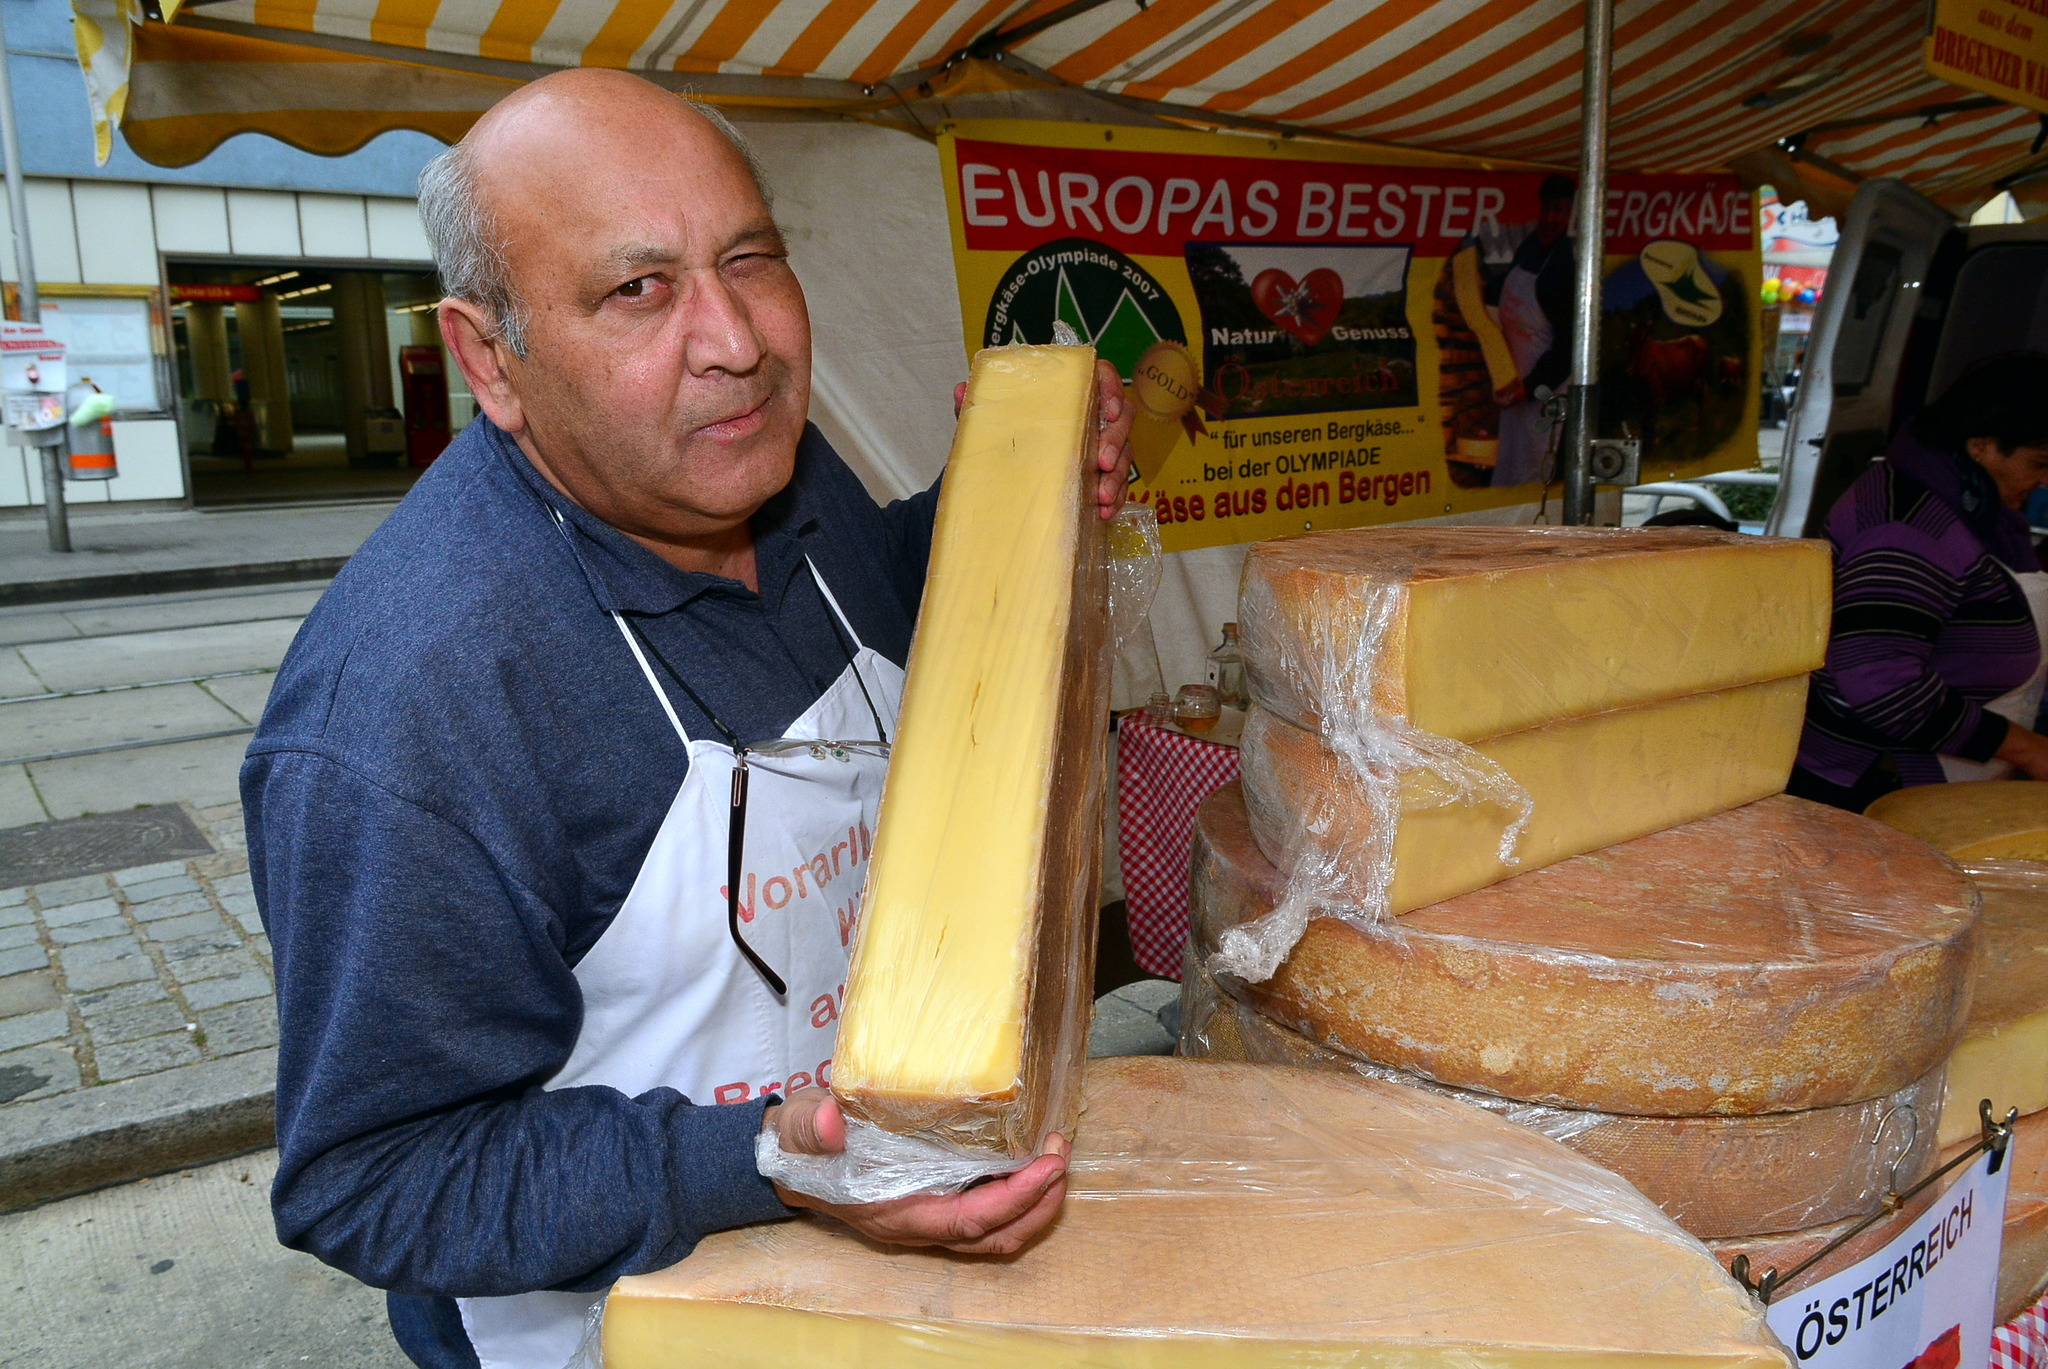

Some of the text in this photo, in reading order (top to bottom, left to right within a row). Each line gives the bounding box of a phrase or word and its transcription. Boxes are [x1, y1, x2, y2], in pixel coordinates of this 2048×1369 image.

[1932, 26, 2023, 90] BREGENZER
[961, 163, 1280, 237] EUROPAS
[1296, 181, 1506, 238] BESTER
[989, 248, 1161, 348] ergkäse-Olympiade 2007
[1211, 326, 1277, 346] Natur
[1331, 325, 1410, 341] Genuss
[1213, 354, 1401, 401] Österreich
[1222, 429, 1248, 449] für
[1251, 425, 1323, 447] unseren
[1203, 462, 1234, 483] bei
[1238, 458, 1272, 478] der
[1275, 447, 1382, 475] OLYMPIADE
[1213, 486, 1268, 519] aus
[1275, 476, 1331, 512] den
[1338, 468, 1432, 507] Bergen
[1795, 1188, 1974, 1361] ÖSTERREICH
